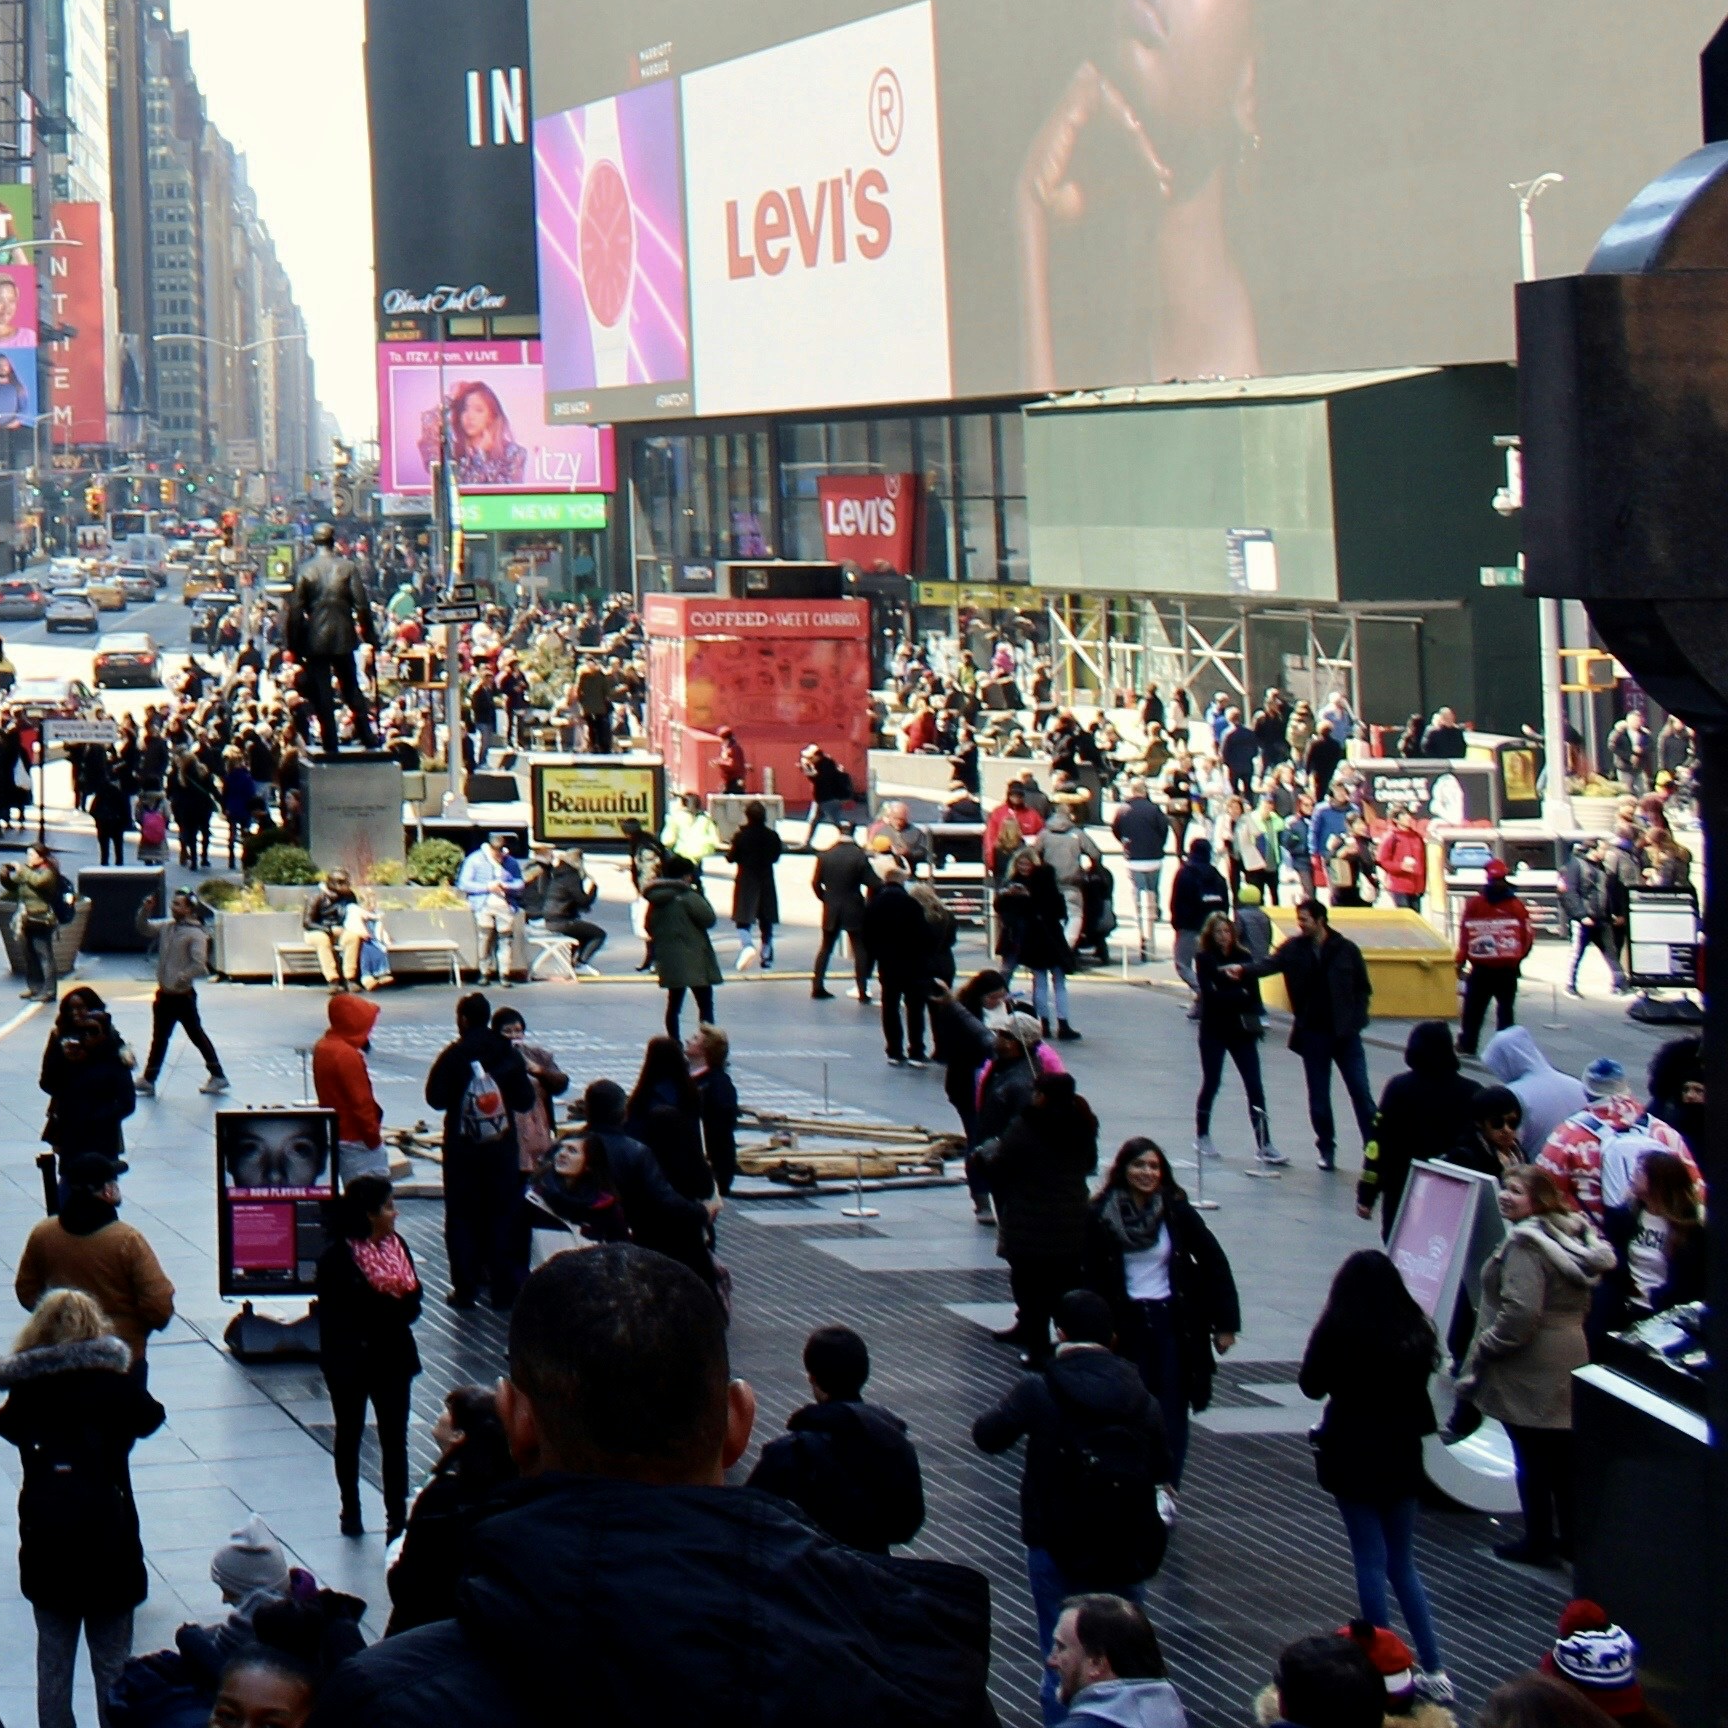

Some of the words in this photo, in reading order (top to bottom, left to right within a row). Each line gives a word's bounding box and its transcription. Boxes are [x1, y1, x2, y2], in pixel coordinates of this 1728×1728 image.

[534, 446, 582, 492] itzy
[511, 503, 558, 520] NEW
[690, 611, 767, 627] COFFEED
[547, 790, 648, 813] Beautiful
